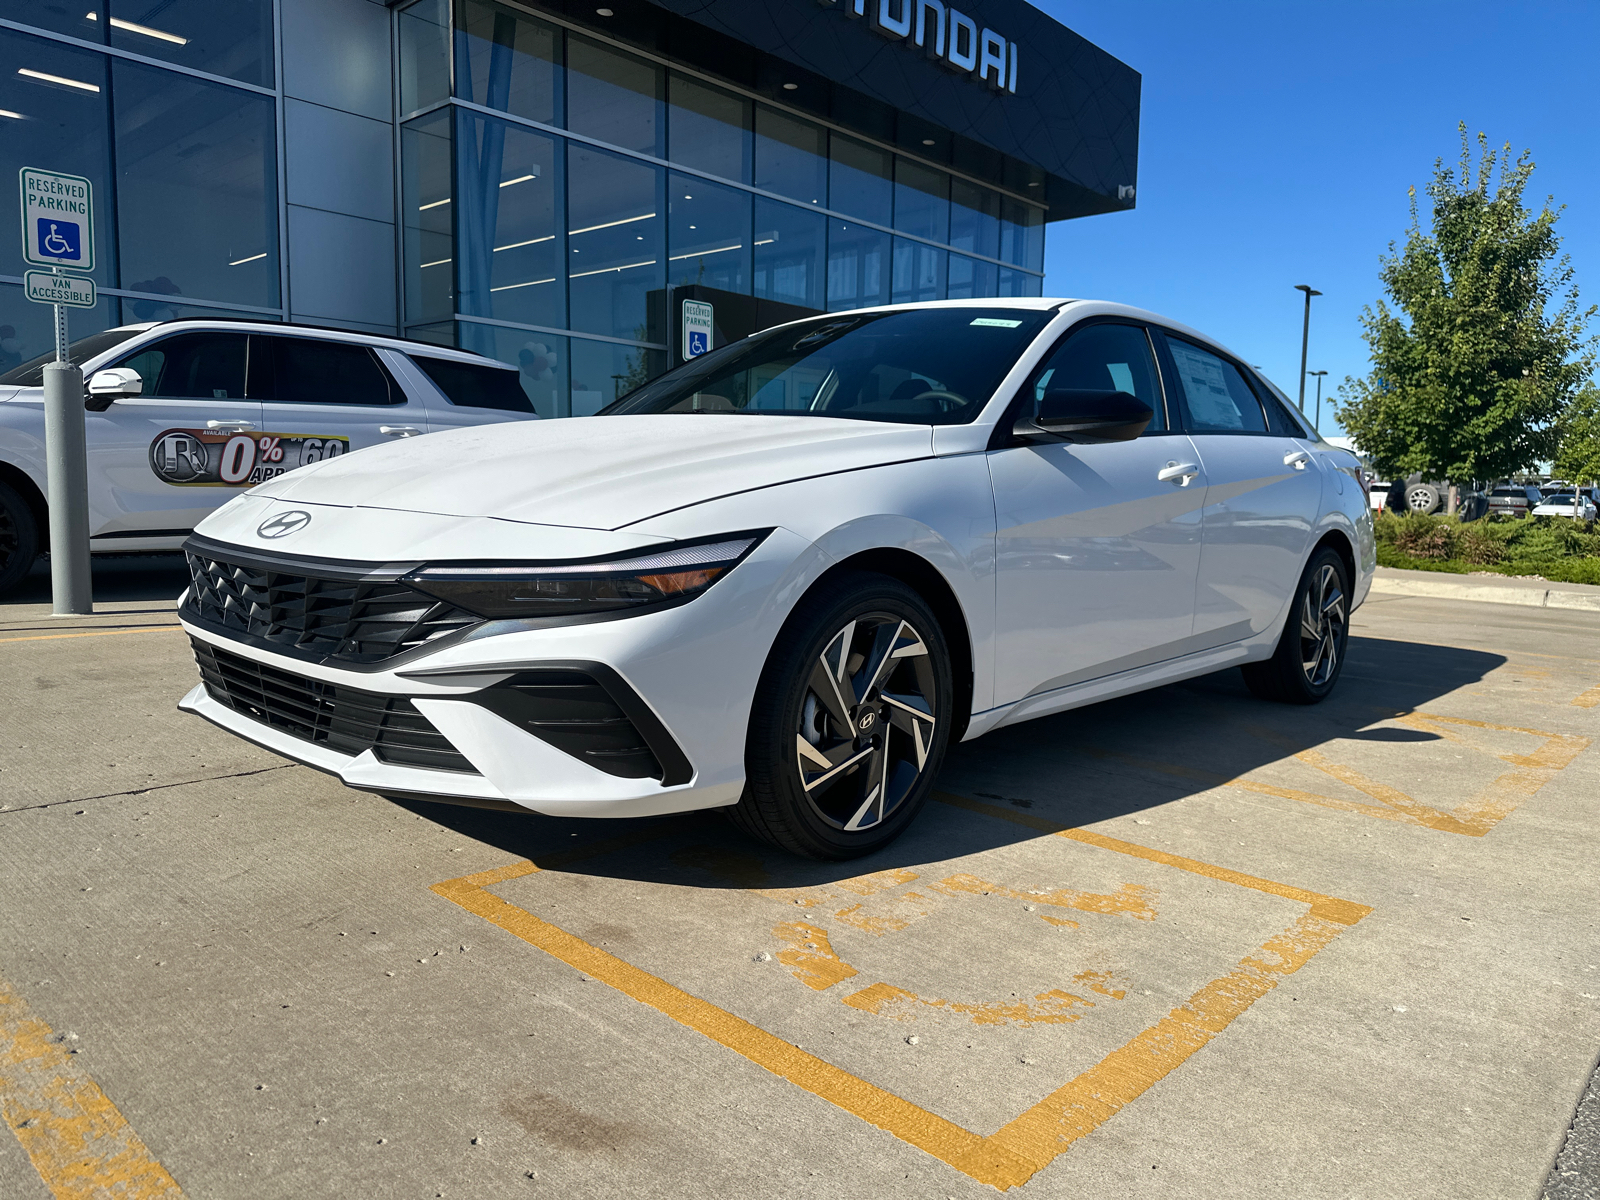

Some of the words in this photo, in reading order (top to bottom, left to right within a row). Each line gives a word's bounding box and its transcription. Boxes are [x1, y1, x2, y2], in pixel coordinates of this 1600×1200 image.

[831, 0, 1018, 94] UNDAI
[28, 177, 85, 199] RESERVED
[28, 193, 86, 214] PARKING
[52, 279, 71, 289] VAN
[32, 287, 91, 302] ACCESSIBLE
[686, 306, 710, 317] RESERVED
[686, 316, 710, 327] PARKING
